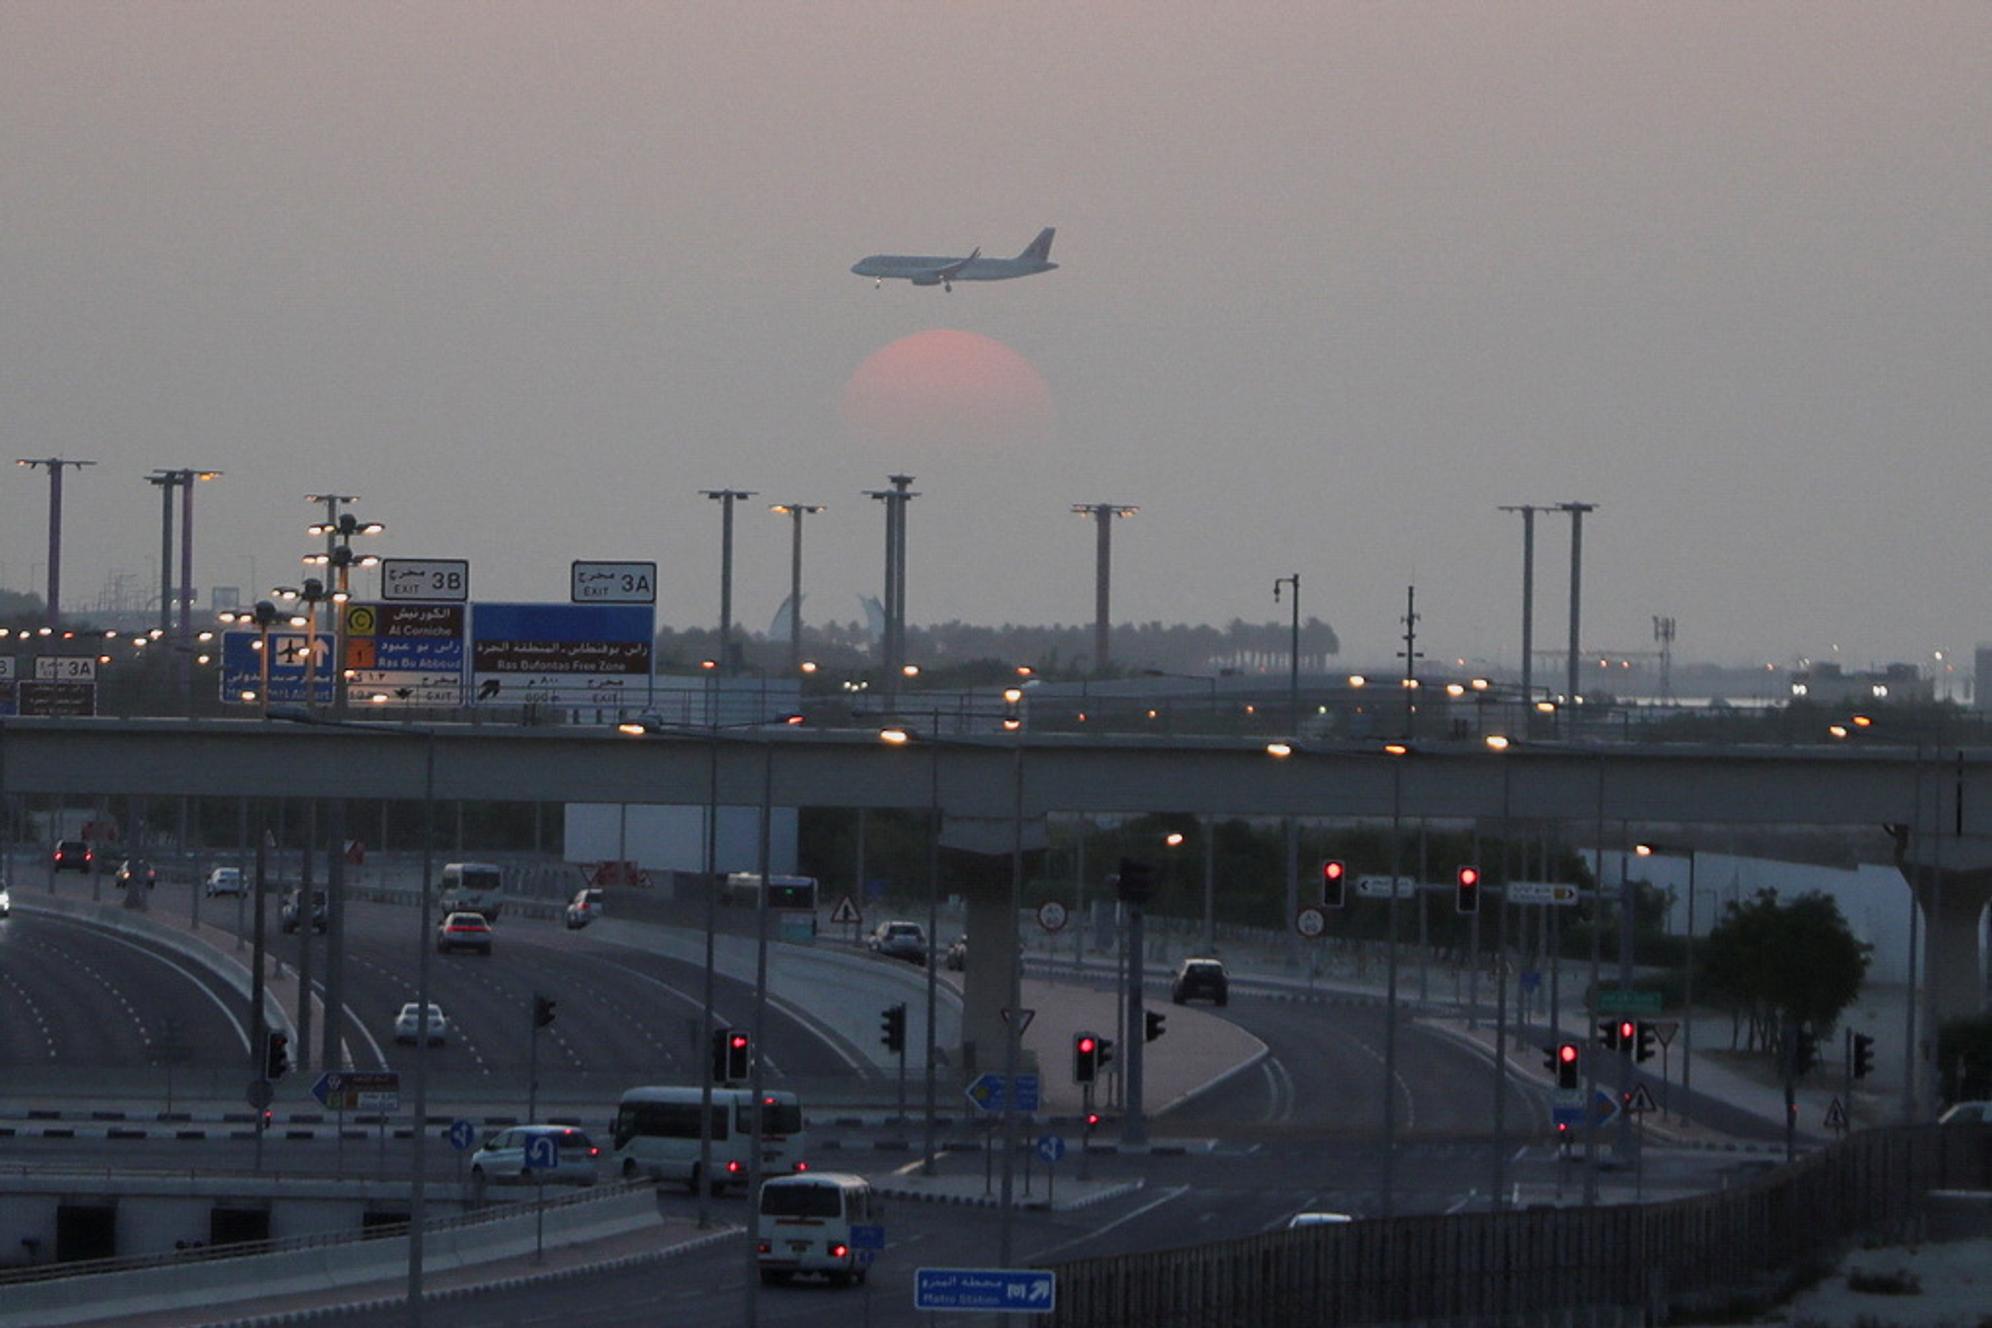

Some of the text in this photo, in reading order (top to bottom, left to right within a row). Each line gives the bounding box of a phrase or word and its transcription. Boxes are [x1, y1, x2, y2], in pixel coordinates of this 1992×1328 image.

[389, 570, 425, 580] مخرج
[432, 572, 461, 590] 3B
[622, 574, 650, 593] 3A
[395, 584, 419, 593] EXIT
[583, 586, 609, 597] EXIT
[403, 625, 452, 637] Corniche
[68, 660, 92, 677] 3A
[497, 660, 518, 670] Ras
[572, 661, 597, 671] Free
[599, 661, 626, 671] Zone
[924, 1293, 957, 1304] Metro
